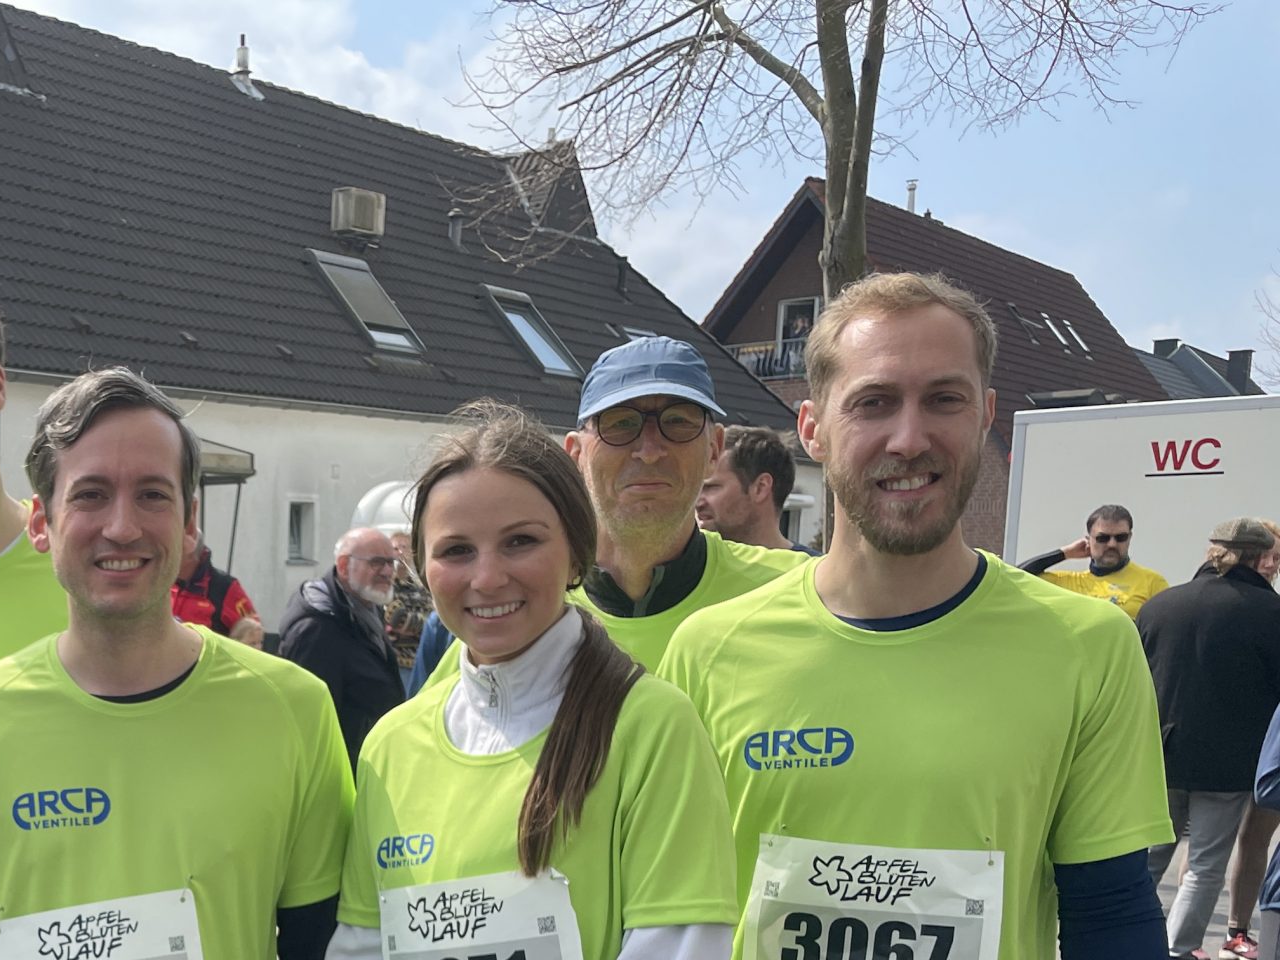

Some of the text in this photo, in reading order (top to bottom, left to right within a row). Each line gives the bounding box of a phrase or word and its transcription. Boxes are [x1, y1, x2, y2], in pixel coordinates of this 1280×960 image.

[1151, 438, 1221, 471] WC
[744, 727, 855, 771] ARCA
[764, 757, 829, 770] VENTILE
[12, 787, 111, 830] ARCA
[33, 816, 90, 830] VENTILE
[377, 834, 434, 869] ARCA
[851, 855, 927, 875] APFEL
[433, 887, 495, 909] APFEL
[840, 885, 913, 906] LAUF
[68, 910, 130, 932] APFEL
[432, 917, 487, 943] LAUF
